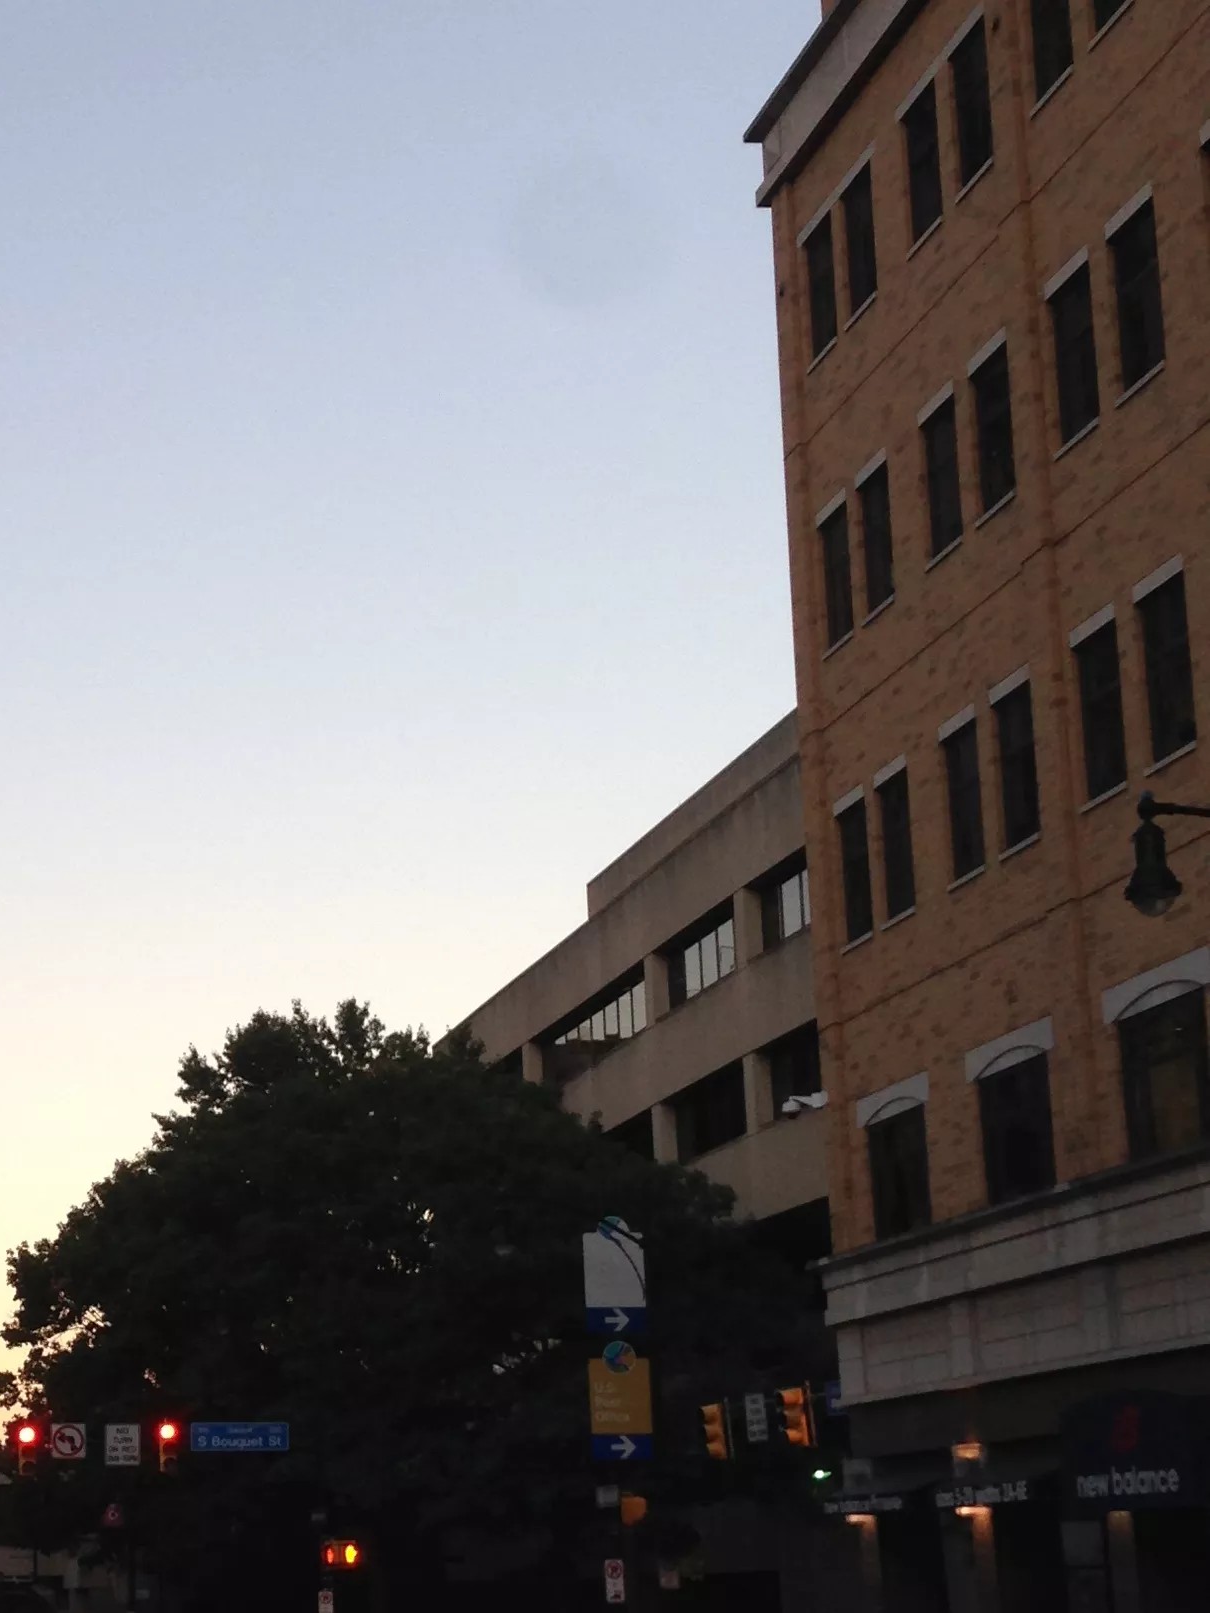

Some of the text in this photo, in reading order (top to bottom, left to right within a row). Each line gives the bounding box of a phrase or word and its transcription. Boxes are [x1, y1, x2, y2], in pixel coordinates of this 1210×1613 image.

[198, 1435, 282, 1450] S Bouquet St
[1076, 1465, 1180, 1498] new balance
